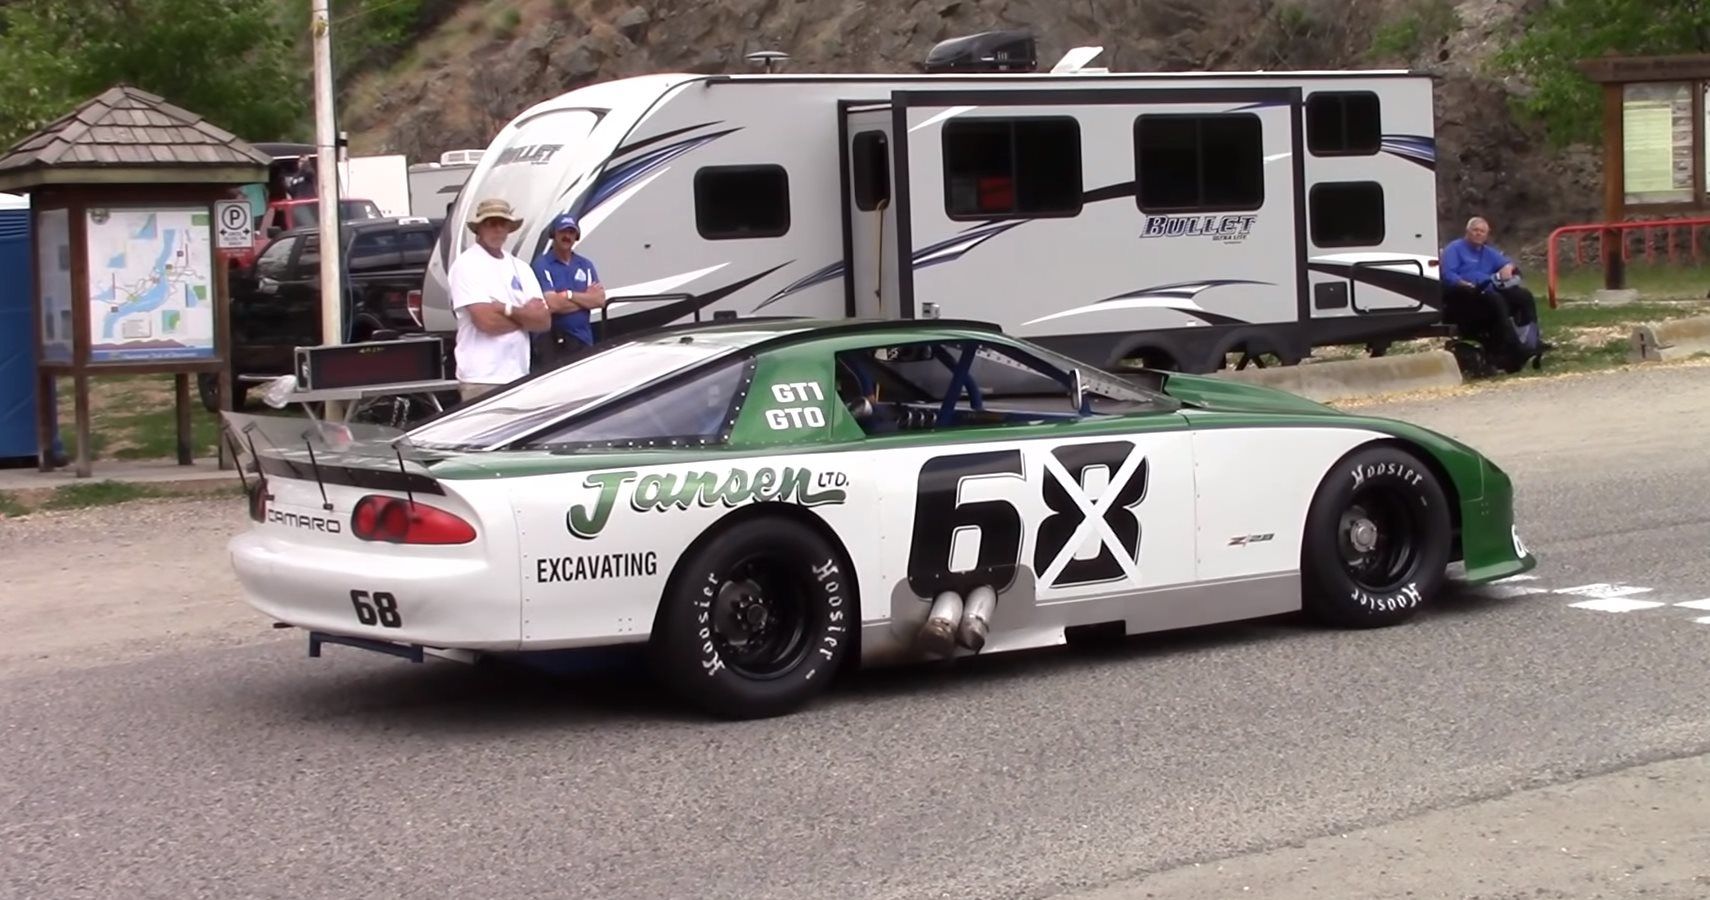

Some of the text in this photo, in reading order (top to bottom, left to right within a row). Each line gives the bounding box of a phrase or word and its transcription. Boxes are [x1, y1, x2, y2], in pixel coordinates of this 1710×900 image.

[230, 209, 241, 226] P
[1139, 213, 1258, 239] BULLET
[771, 381, 825, 403] GT1
[1350, 462, 1423, 490] Hoosier
[566, 466, 850, 540] Jansen LTD.
[267, 508, 341, 534] CAMARO
[536, 551, 658, 584] EXCAVATING
[350, 589, 402, 628] 68
[811, 558, 846, 661] Hoosier
[1350, 581, 1423, 614] Hoosier
[694, 572, 726, 677] Hoosier
